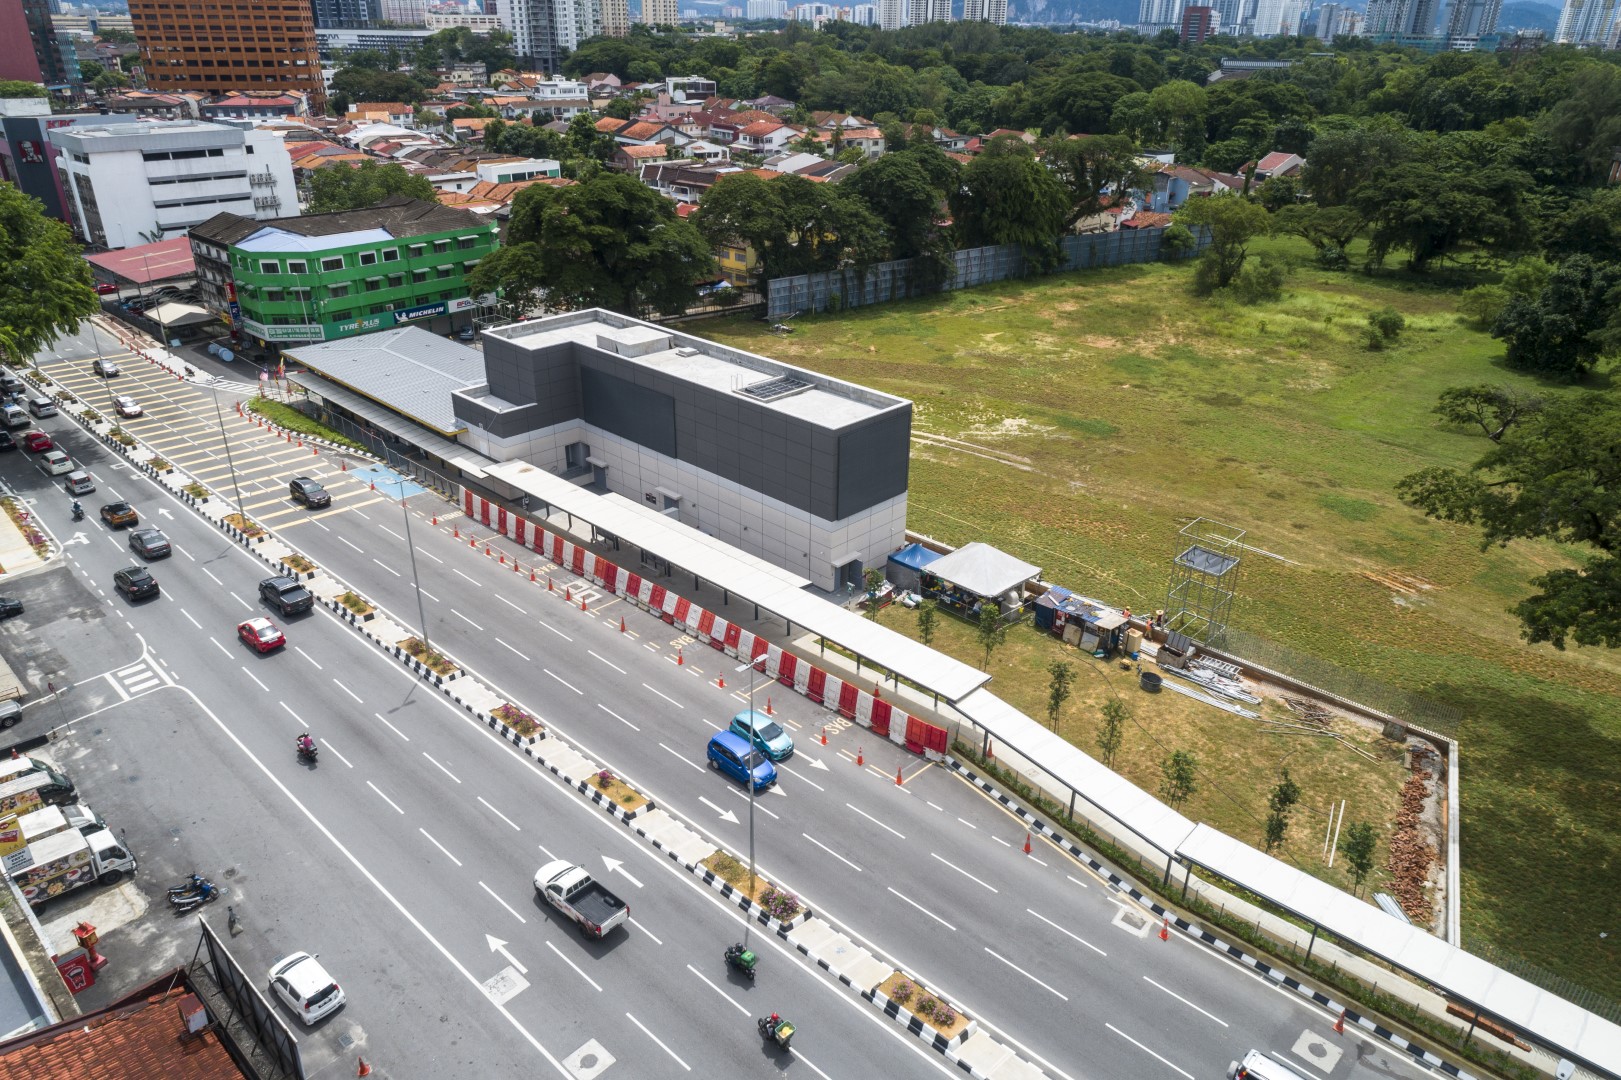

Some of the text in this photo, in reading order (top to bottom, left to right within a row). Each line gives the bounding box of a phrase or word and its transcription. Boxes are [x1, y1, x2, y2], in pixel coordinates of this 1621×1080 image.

[409, 306, 445, 318] MICHELIN
[533, 563, 558, 575] BAS
[669, 635, 696, 650] BAS
[823, 717, 853, 735] BAS
